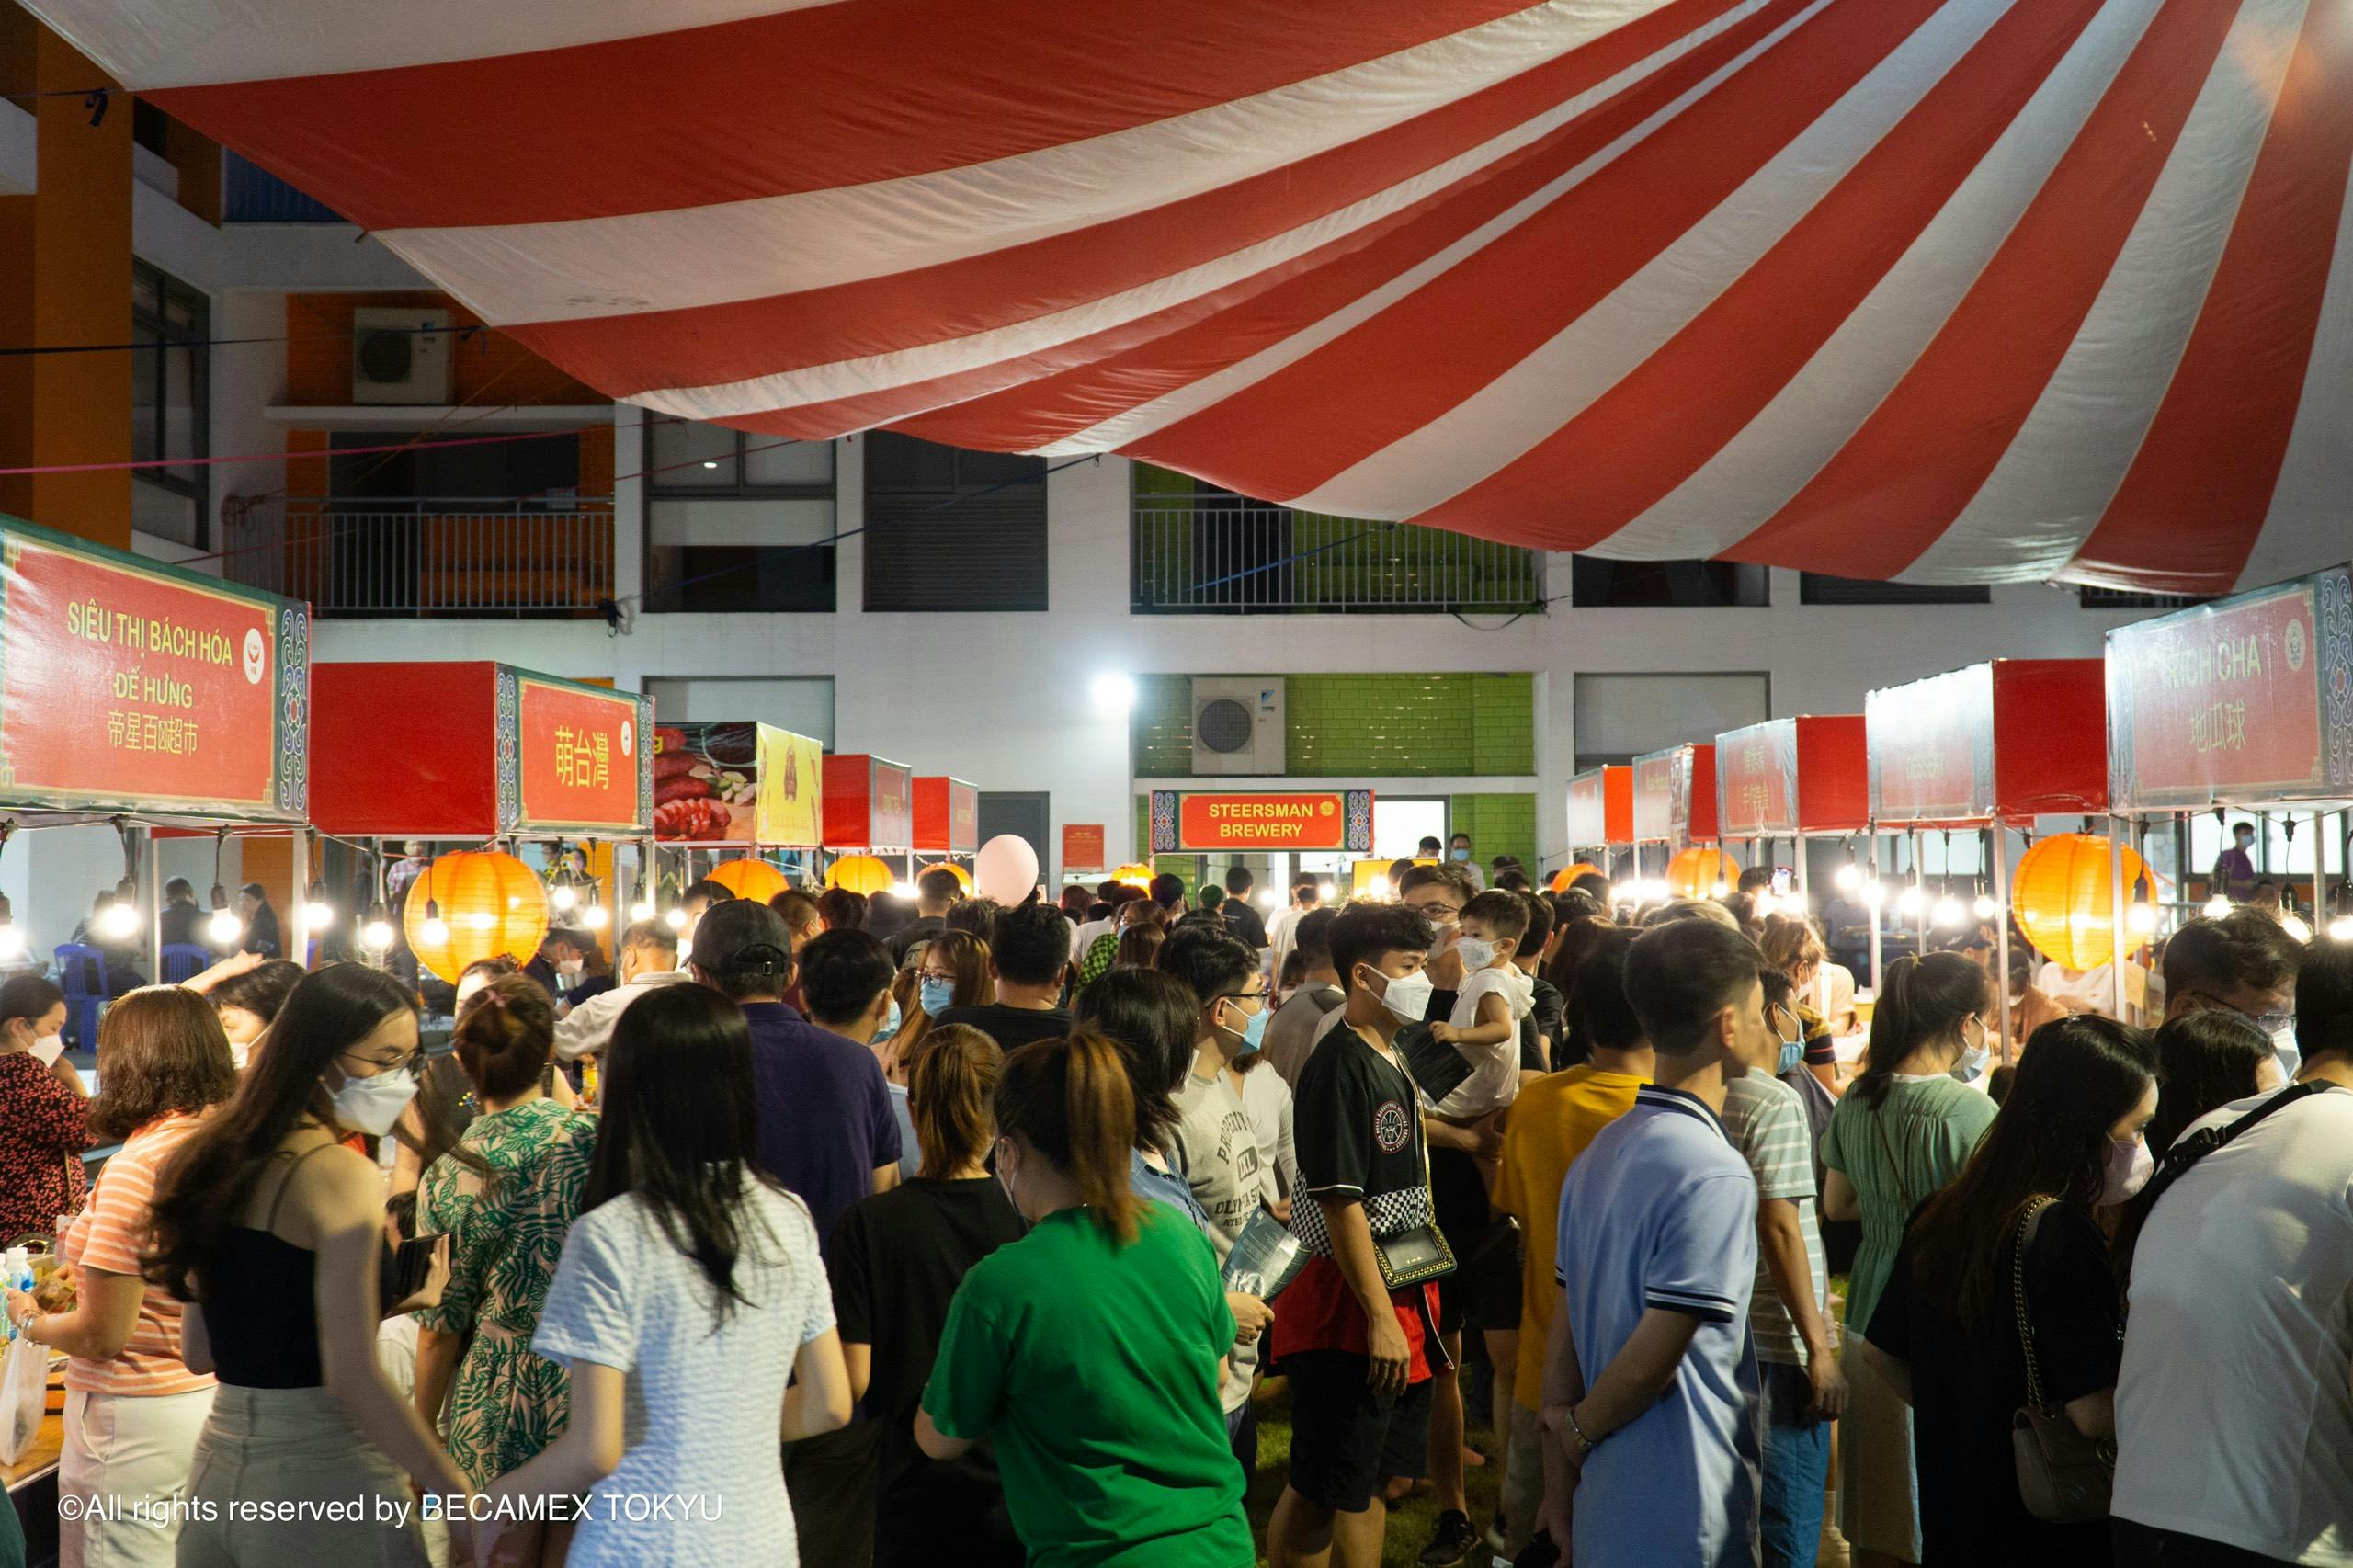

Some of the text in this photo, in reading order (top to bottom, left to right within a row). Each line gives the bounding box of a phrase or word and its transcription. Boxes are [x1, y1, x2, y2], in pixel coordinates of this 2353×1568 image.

[68, 597, 234, 666] SIÊU THỊ BÁCH HÓA
[2218, 634, 2263, 681] CHA
[113, 665, 140, 701] ĐẾ
[2189, 699, 2247, 753] 地瓜球
[555, 725, 609, 790] 萌台灣
[1209, 803, 1313, 818] STEERSMAN
[1220, 823, 1303, 838] BREWERY
